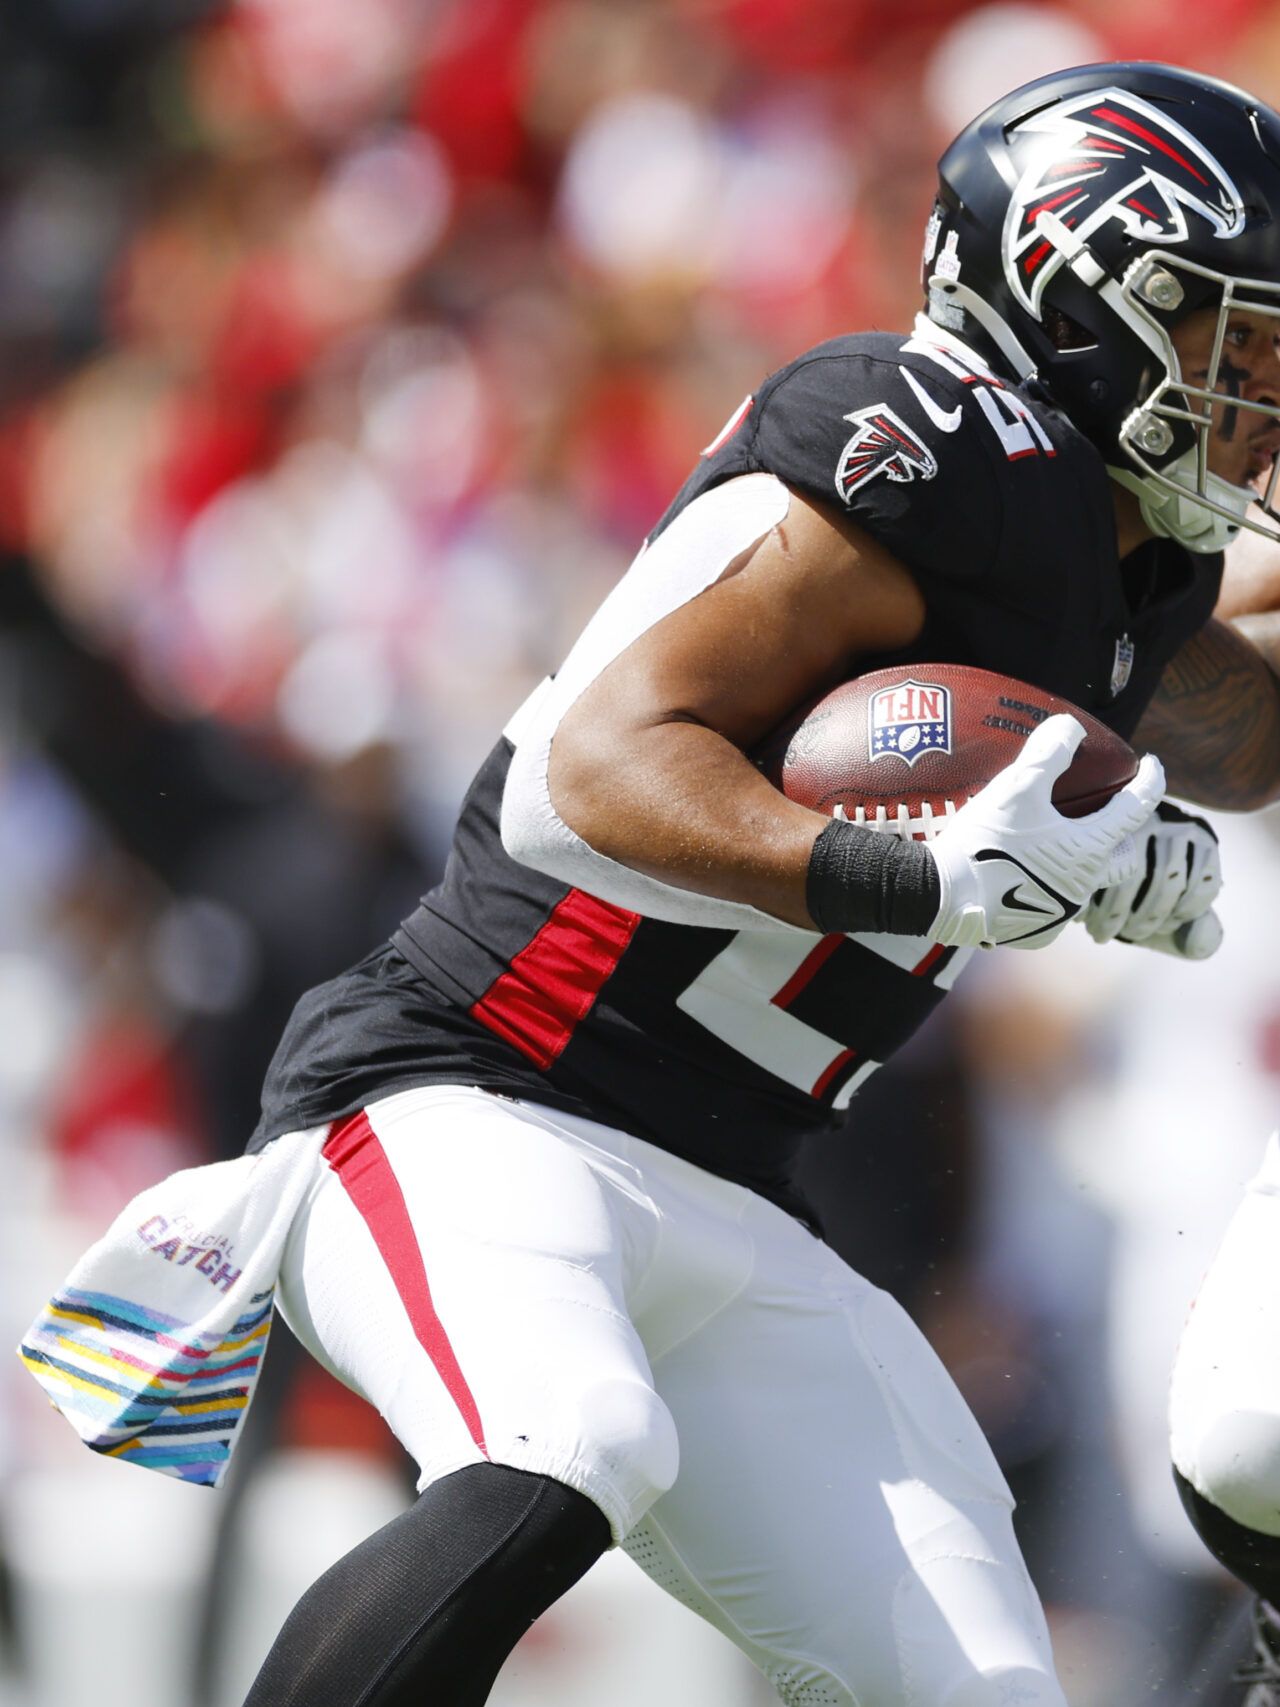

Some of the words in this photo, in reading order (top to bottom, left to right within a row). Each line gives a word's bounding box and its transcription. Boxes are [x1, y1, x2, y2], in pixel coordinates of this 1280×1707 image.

[878, 688, 942, 723] NFL
[137, 1214, 243, 1295] CATCH
[171, 1214, 235, 1259] CRUCIAL
